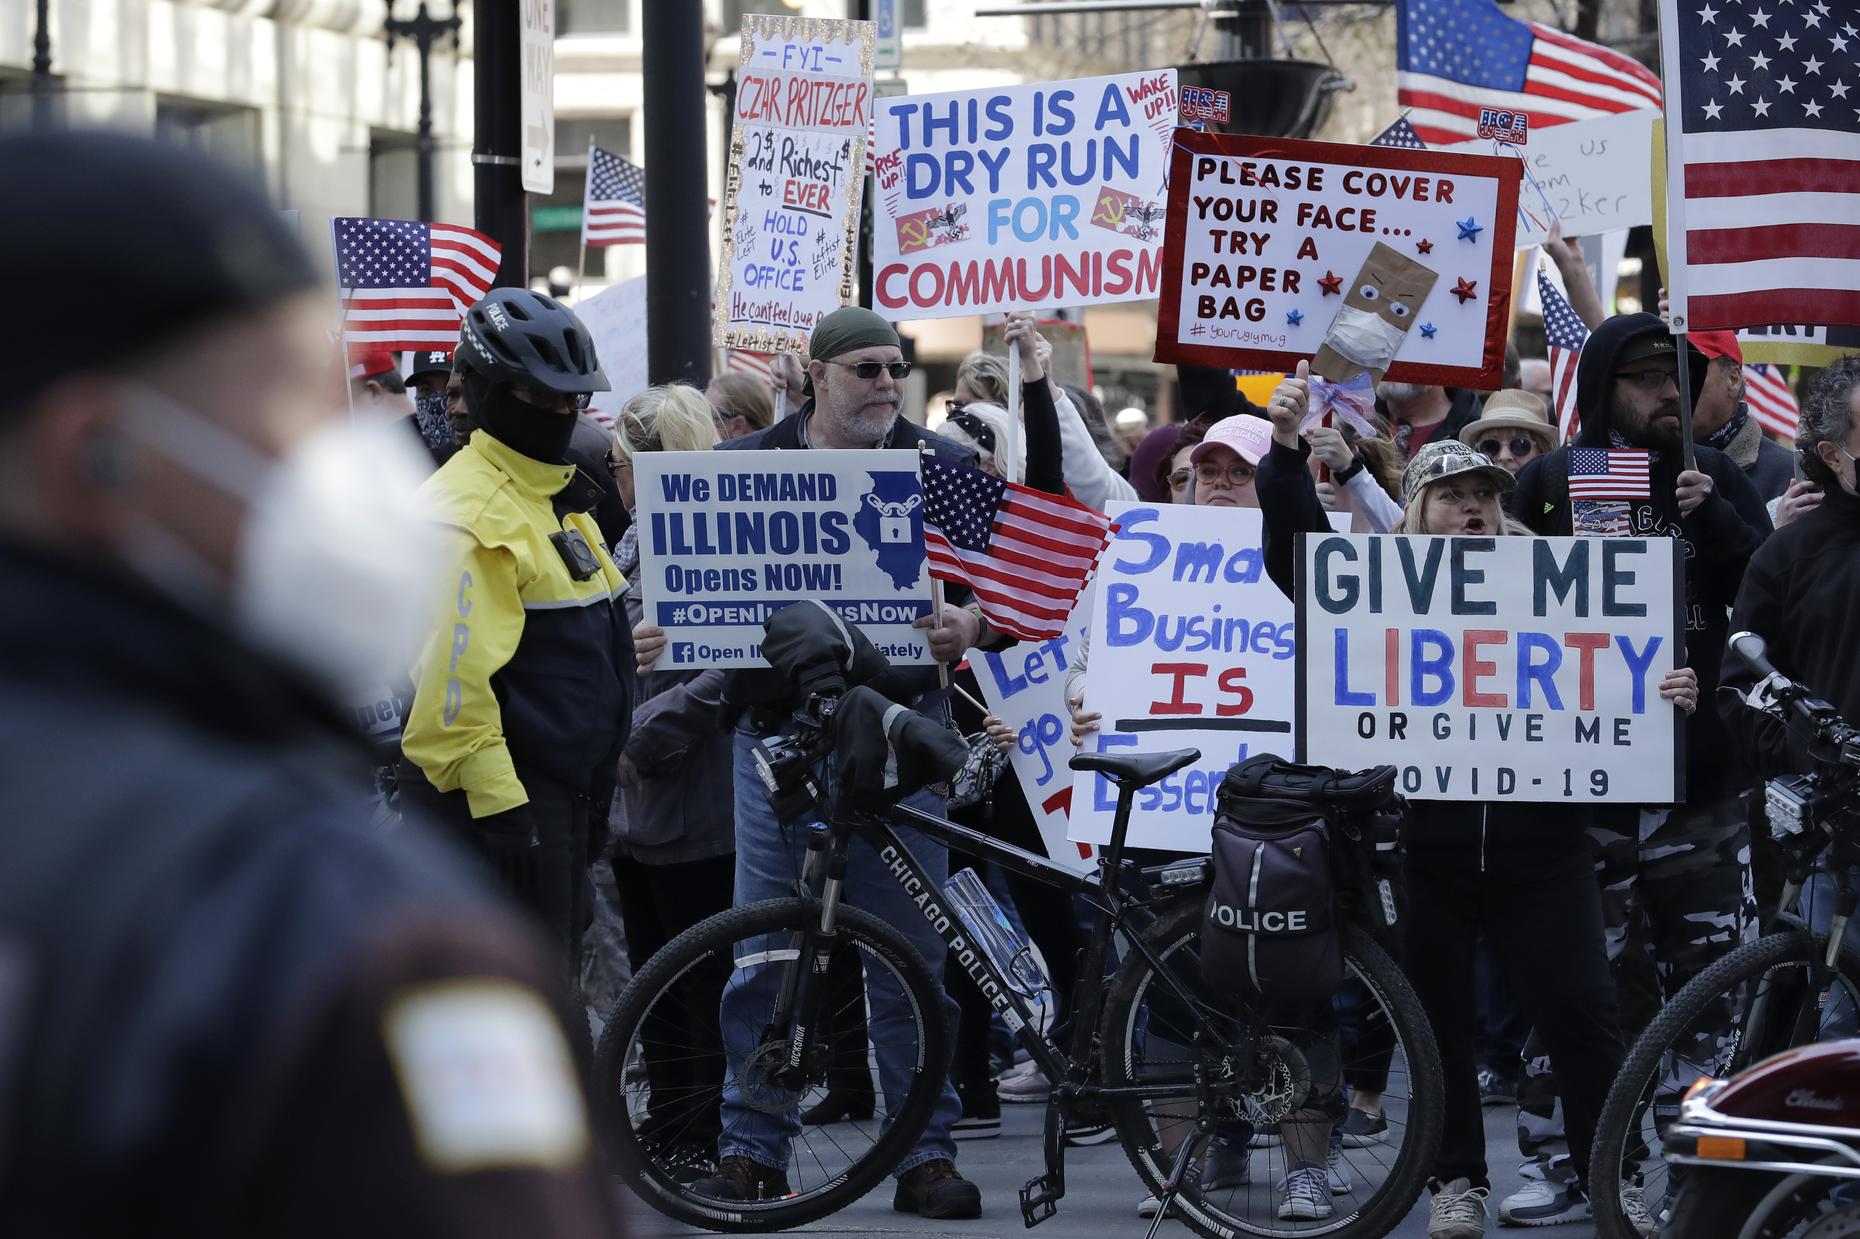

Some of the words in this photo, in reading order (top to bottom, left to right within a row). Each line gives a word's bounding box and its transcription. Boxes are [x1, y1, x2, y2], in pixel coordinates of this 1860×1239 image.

[738, 75, 782, 122] CZAR
[786, 79, 868, 128] PRITZGER
[1126, 73, 1169, 105] WAKE
[1180, 86, 1231, 124] USA
[889, 95, 1014, 150] THIS
[1033, 89, 1076, 137] IS
[1094, 83, 1131, 131] A
[779, 136, 843, 187] Richest
[875, 147, 903, 179] RISE
[906, 146, 1011, 200] DRY
[1027, 133, 1140, 191] RUN
[1197, 157, 1325, 193] PLEASE
[1342, 170, 1456, 204] COVER
[759, 178, 773, 196] to
[783, 179, 830, 211] EVER
[763, 209, 808, 236] HOLD
[987, 194, 1081, 246] FOR
[1193, 195, 1279, 224] YOUR
[1296, 203, 1412, 237] FACE...
[771, 238, 801, 267] U.S.
[1209, 229, 1271, 257] TRY
[1296, 236, 1319, 262] A
[744, 263, 805, 291] OFFICE
[875, 246, 1164, 309] COMMUNISM
[1190, 262, 1301, 294] PAPER
[486, 303, 509, 332] POLICE
[732, 291, 747, 319] He
[1197, 295, 1266, 323] BAG
[660, 474, 710, 503] We
[717, 473, 837, 502] DEMAND
[651, 511, 851, 556] ILLINOIS
[1112, 507, 1263, 584] Sma
[664, 564, 758, 595] Opens
[765, 563, 842, 592] NOW!
[1314, 536, 1498, 616] GIVE
[1532, 539, 1648, 618] ME
[1106, 582, 1295, 660] Busines
[698, 645, 744, 661] Open
[1334, 628, 1664, 714] LIBERTY
[1149, 663, 1254, 717] IS
[1357, 712, 1408, 741] OR
[1432, 713, 1545, 743] GIVE
[1575, 716, 1633, 747] ME
[1017, 713, 1064, 787] go
[1402, 766, 1610, 797] OVID-19
[879, 845, 951, 935] CHICAGO
[948, 935, 1009, 1012] POLICE
